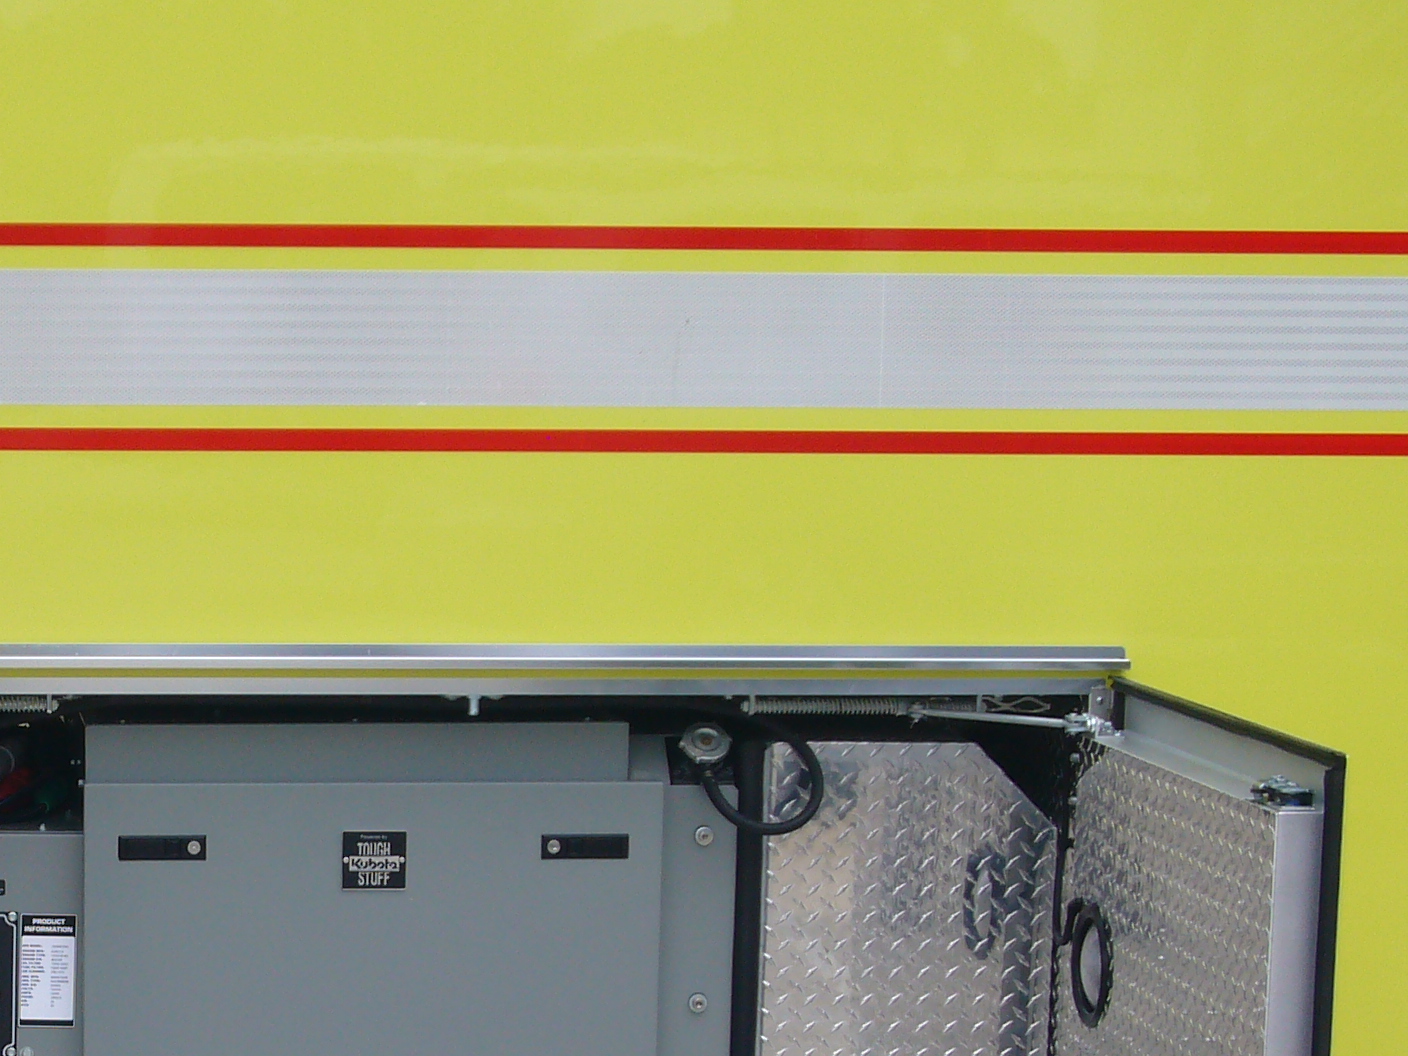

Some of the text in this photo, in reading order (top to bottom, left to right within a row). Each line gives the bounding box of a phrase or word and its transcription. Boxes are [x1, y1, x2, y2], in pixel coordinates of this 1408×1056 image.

[357, 842, 391, 856] TOUGH
[351, 858, 398, 870] Kubota
[357, 872, 390, 886] STUFF
[32, 917, 67, 925] PRODUCT
[24, 925, 74, 933] INFORMATION
